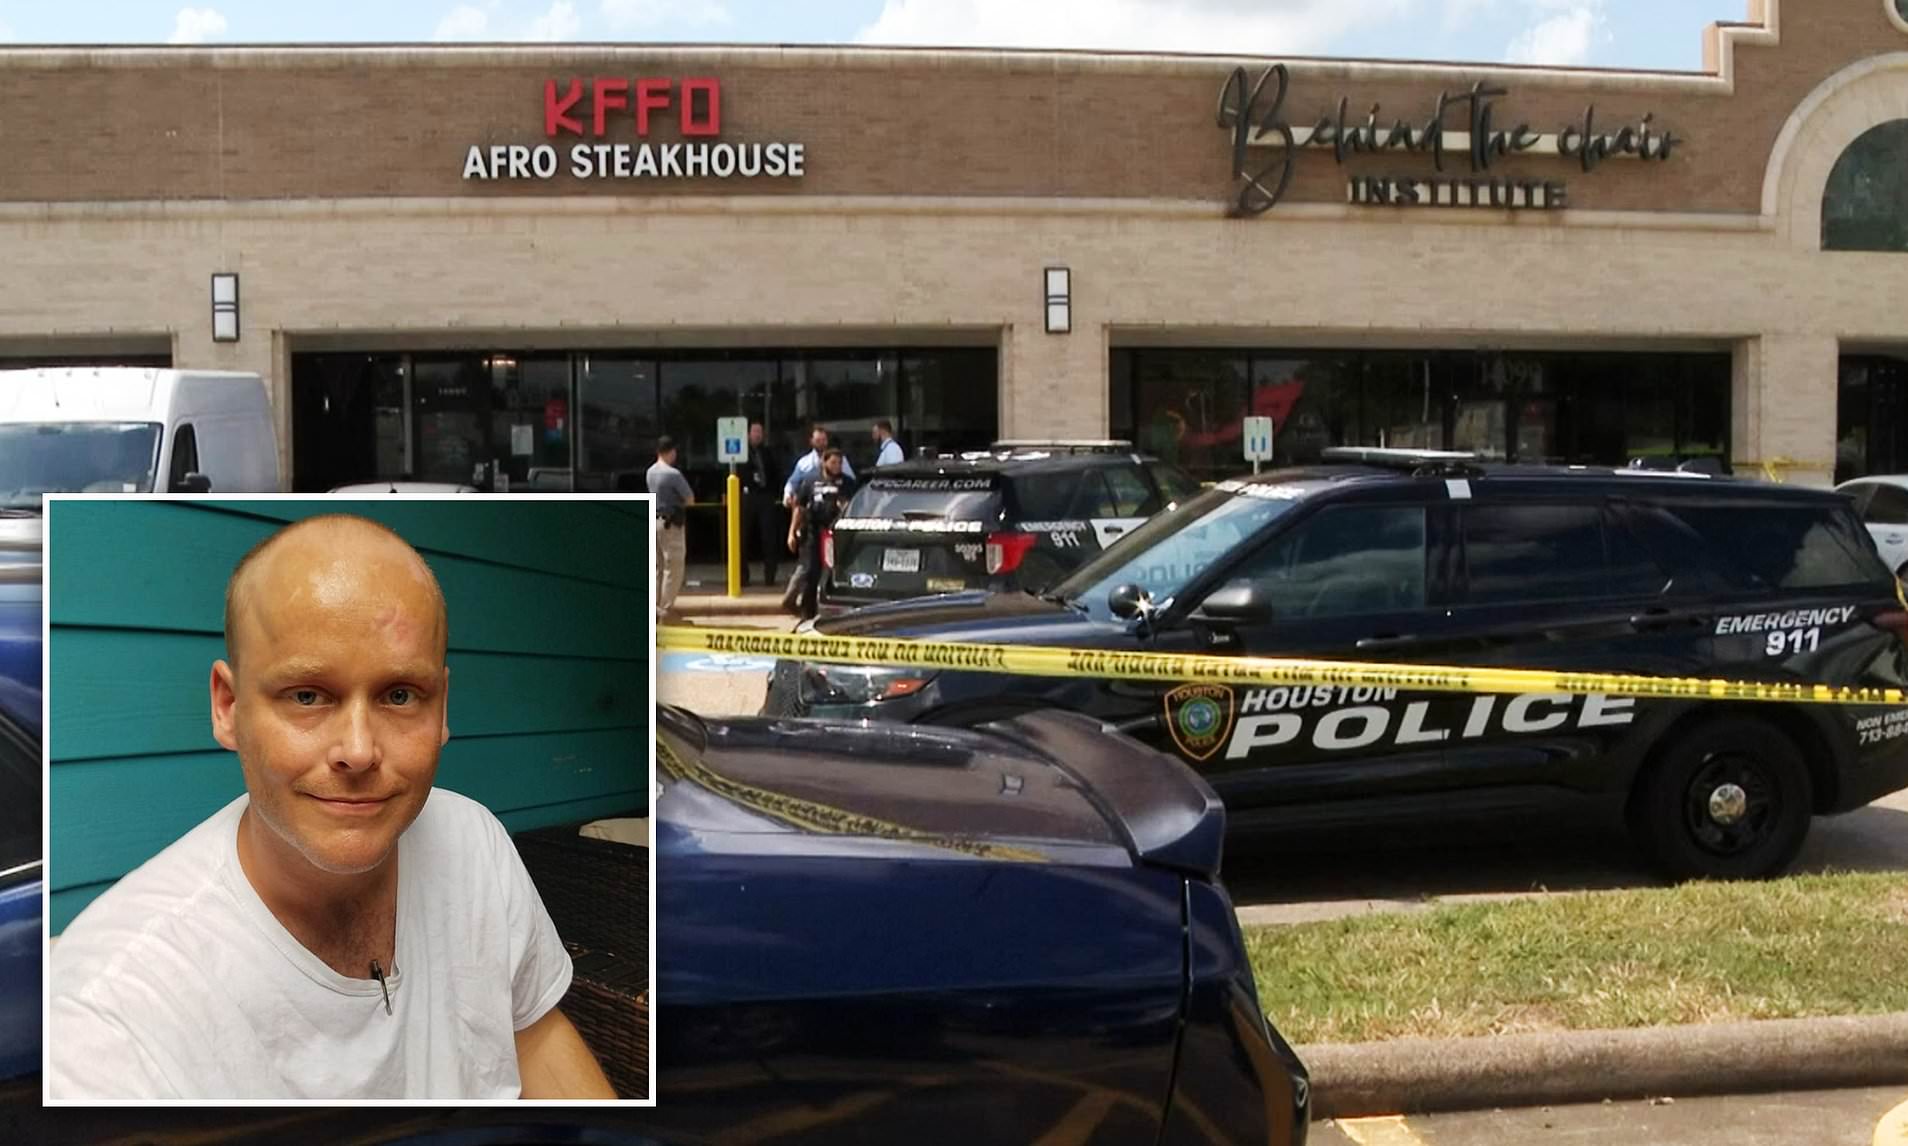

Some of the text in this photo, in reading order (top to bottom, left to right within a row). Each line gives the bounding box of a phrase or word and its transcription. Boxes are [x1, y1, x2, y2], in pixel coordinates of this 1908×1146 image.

[543, 78, 721, 137] KFFO
[1216, 62, 1448, 218] Behind
[1557, 104, 1683, 173] chair
[462, 142, 805, 180] AFRO STEAKHOUSE
[1350, 176, 1568, 209] INSTITUTE
[1050, 531, 1081, 548] 911
[1714, 605, 1856, 635] EMERGENCY
[1765, 627, 1821, 656] 911
[1240, 686, 1400, 714] HOUSTON
[1224, 694, 1637, 761] POLICE
[1855, 715, 1882, 732] NON
